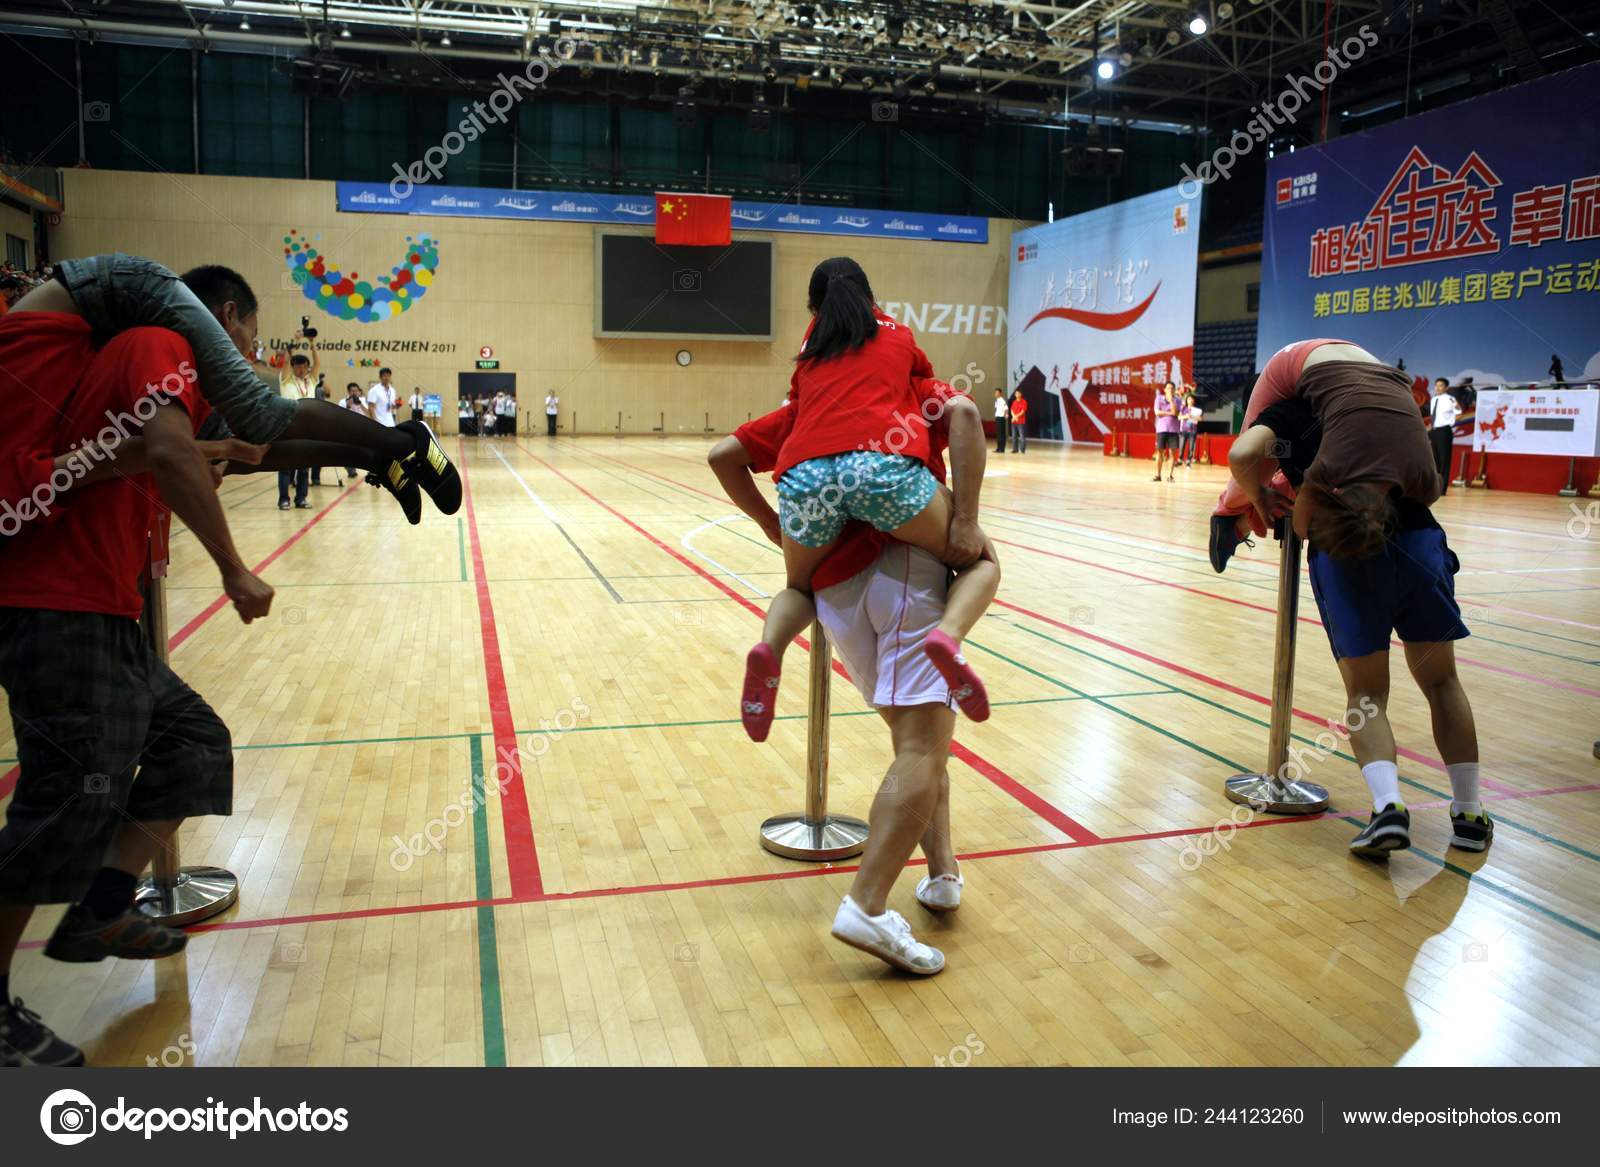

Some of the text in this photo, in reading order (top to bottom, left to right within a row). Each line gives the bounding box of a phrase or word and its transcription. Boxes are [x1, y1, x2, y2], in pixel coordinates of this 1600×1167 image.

[354, 340, 429, 352] SHENZHEN
[432, 344, 457, 353] 2011
[481, 347, 491, 358] 3
